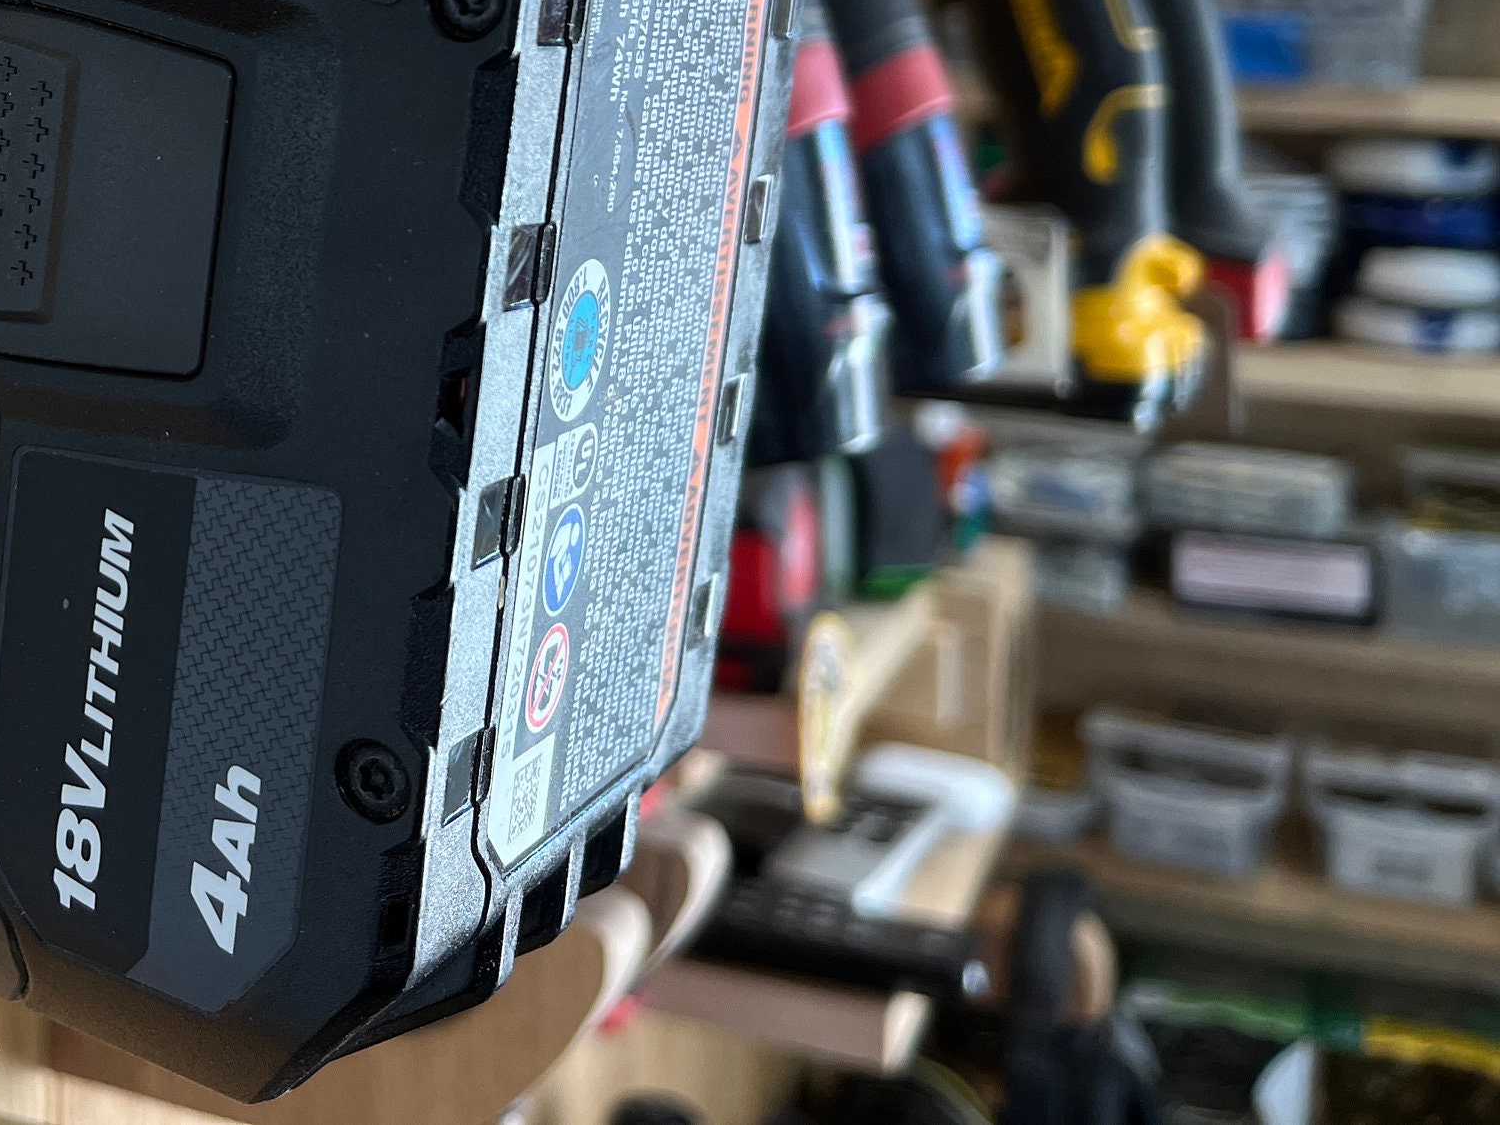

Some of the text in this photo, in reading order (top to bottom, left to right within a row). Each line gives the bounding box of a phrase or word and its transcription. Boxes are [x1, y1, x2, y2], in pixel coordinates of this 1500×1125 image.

[608, 33, 627, 102] 74Wh
[664, 38, 676, 72] los
[683, 29, 708, 164] uniquement
[633, 95, 653, 182] cambie
[648, 79, 671, 202] terminales
[649, 93, 661, 129] del
[664, 103, 684, 200] incendio
[693, 83, 716, 209] d'incendies
[709, 89, 722, 141] from
[723, 103, 735, 139] Not
[628, 188, 641, 225] los
[632, 140, 655, 248] operador
[652, 157, 669, 218] abra,
[666, 140, 687, 233] pendant
[681, 152, 700, 247] chauffer
[702, 154, 714, 197] tool
[711, 144, 730, 222] Expose
[665, 197, 686, 300] chargeur
[692, 209, 707, 269] when
[702, 204, 714, 246] Use
[608, 229, 636, 378] aditamentos
[634, 242, 650, 310] corto.
[641, 227, 658, 309] rompa,
[644, 258, 664, 353] lesiones
[694, 249, 709, 297] only
[696, 166, 740, 425] AVERTISSEMENT
[585, 275, 608, 393] RECYCLE
[615, 321, 632, 388] P118.
[624, 314, 641, 388] Utilice
[689, 301, 702, 349] with
[637, 358, 649, 398] por
[676, 352, 695, 437] charger
[562, 432, 576, 500] CERTIFIED
[595, 402, 613, 484] realice
[605, 396, 622, 468] Retire
[609, 420, 627, 501] unidad
[646, 407, 659, 463] dans
[660, 410, 673, 452] pas
[663, 376, 685, 479] changing
[580, 486, 602, 582] ajustes.
[602, 443, 632, 600] temperaturas
[622, 411, 652, 573] remplacement
[592, 504, 616, 626] solamente
[629, 495, 648, 580] manuel
[81, 508, 135, 767] LITHIUM
[499, 459, 551, 762] CS21073N720315
[598, 586, 619, 685] exponga
[616, 574, 630, 618] des
[585, 628, 597, 673] con
[587, 605, 608, 706] mayores
[558, 670, 585, 813] herramienta
[565, 700, 588, 810] cargador
[584, 710, 603, 793] unidad
[190, 765, 261, 954] 4Ah
